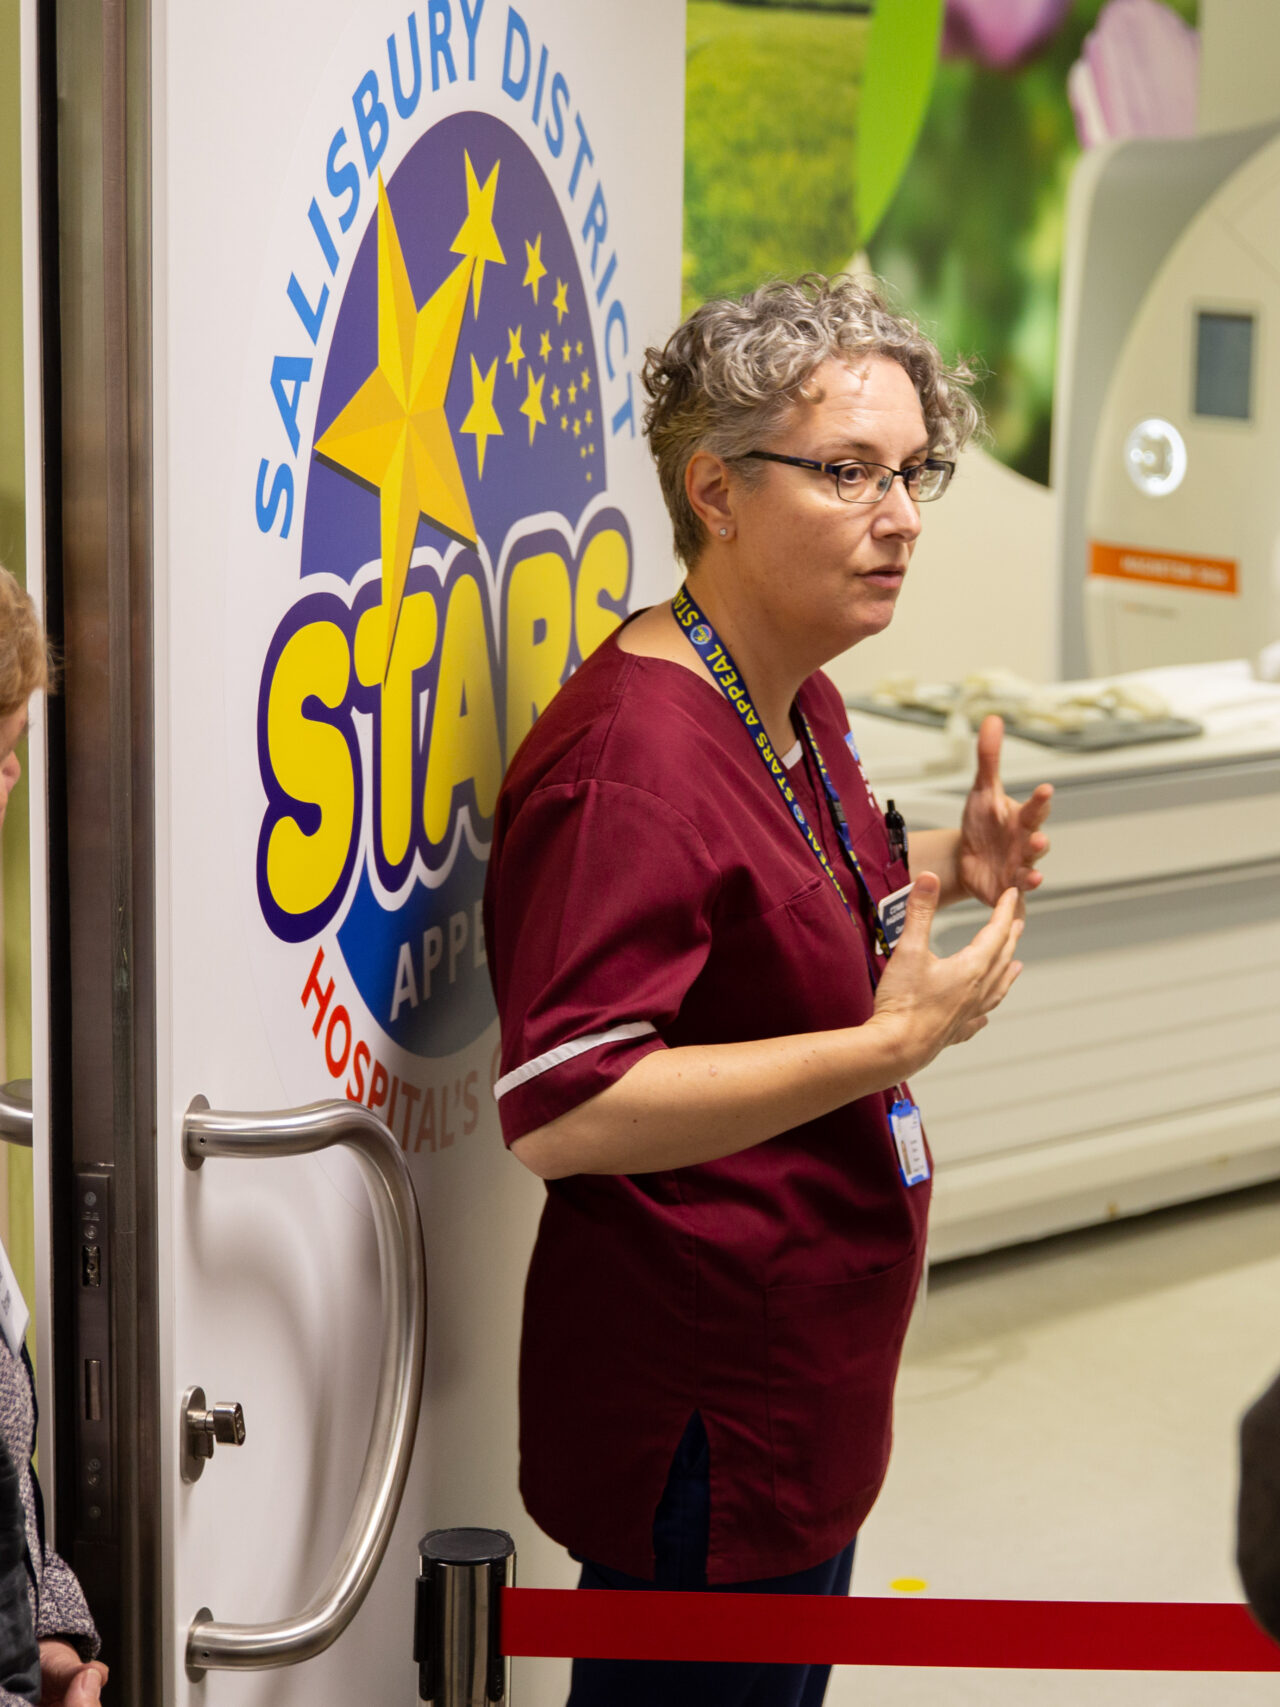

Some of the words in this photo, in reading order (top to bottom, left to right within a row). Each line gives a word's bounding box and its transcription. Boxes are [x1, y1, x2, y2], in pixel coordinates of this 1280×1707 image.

[256, 0, 485, 539] SALISBURY
[502, 5, 636, 440] DISTRICT
[672, 588, 700, 627] STA
[706, 644, 760, 725] APPEAL
[755, 732, 794, 802] STARS
[389, 899, 488, 1023] APPE
[301, 944, 480, 1153] HOSPITAL'S
